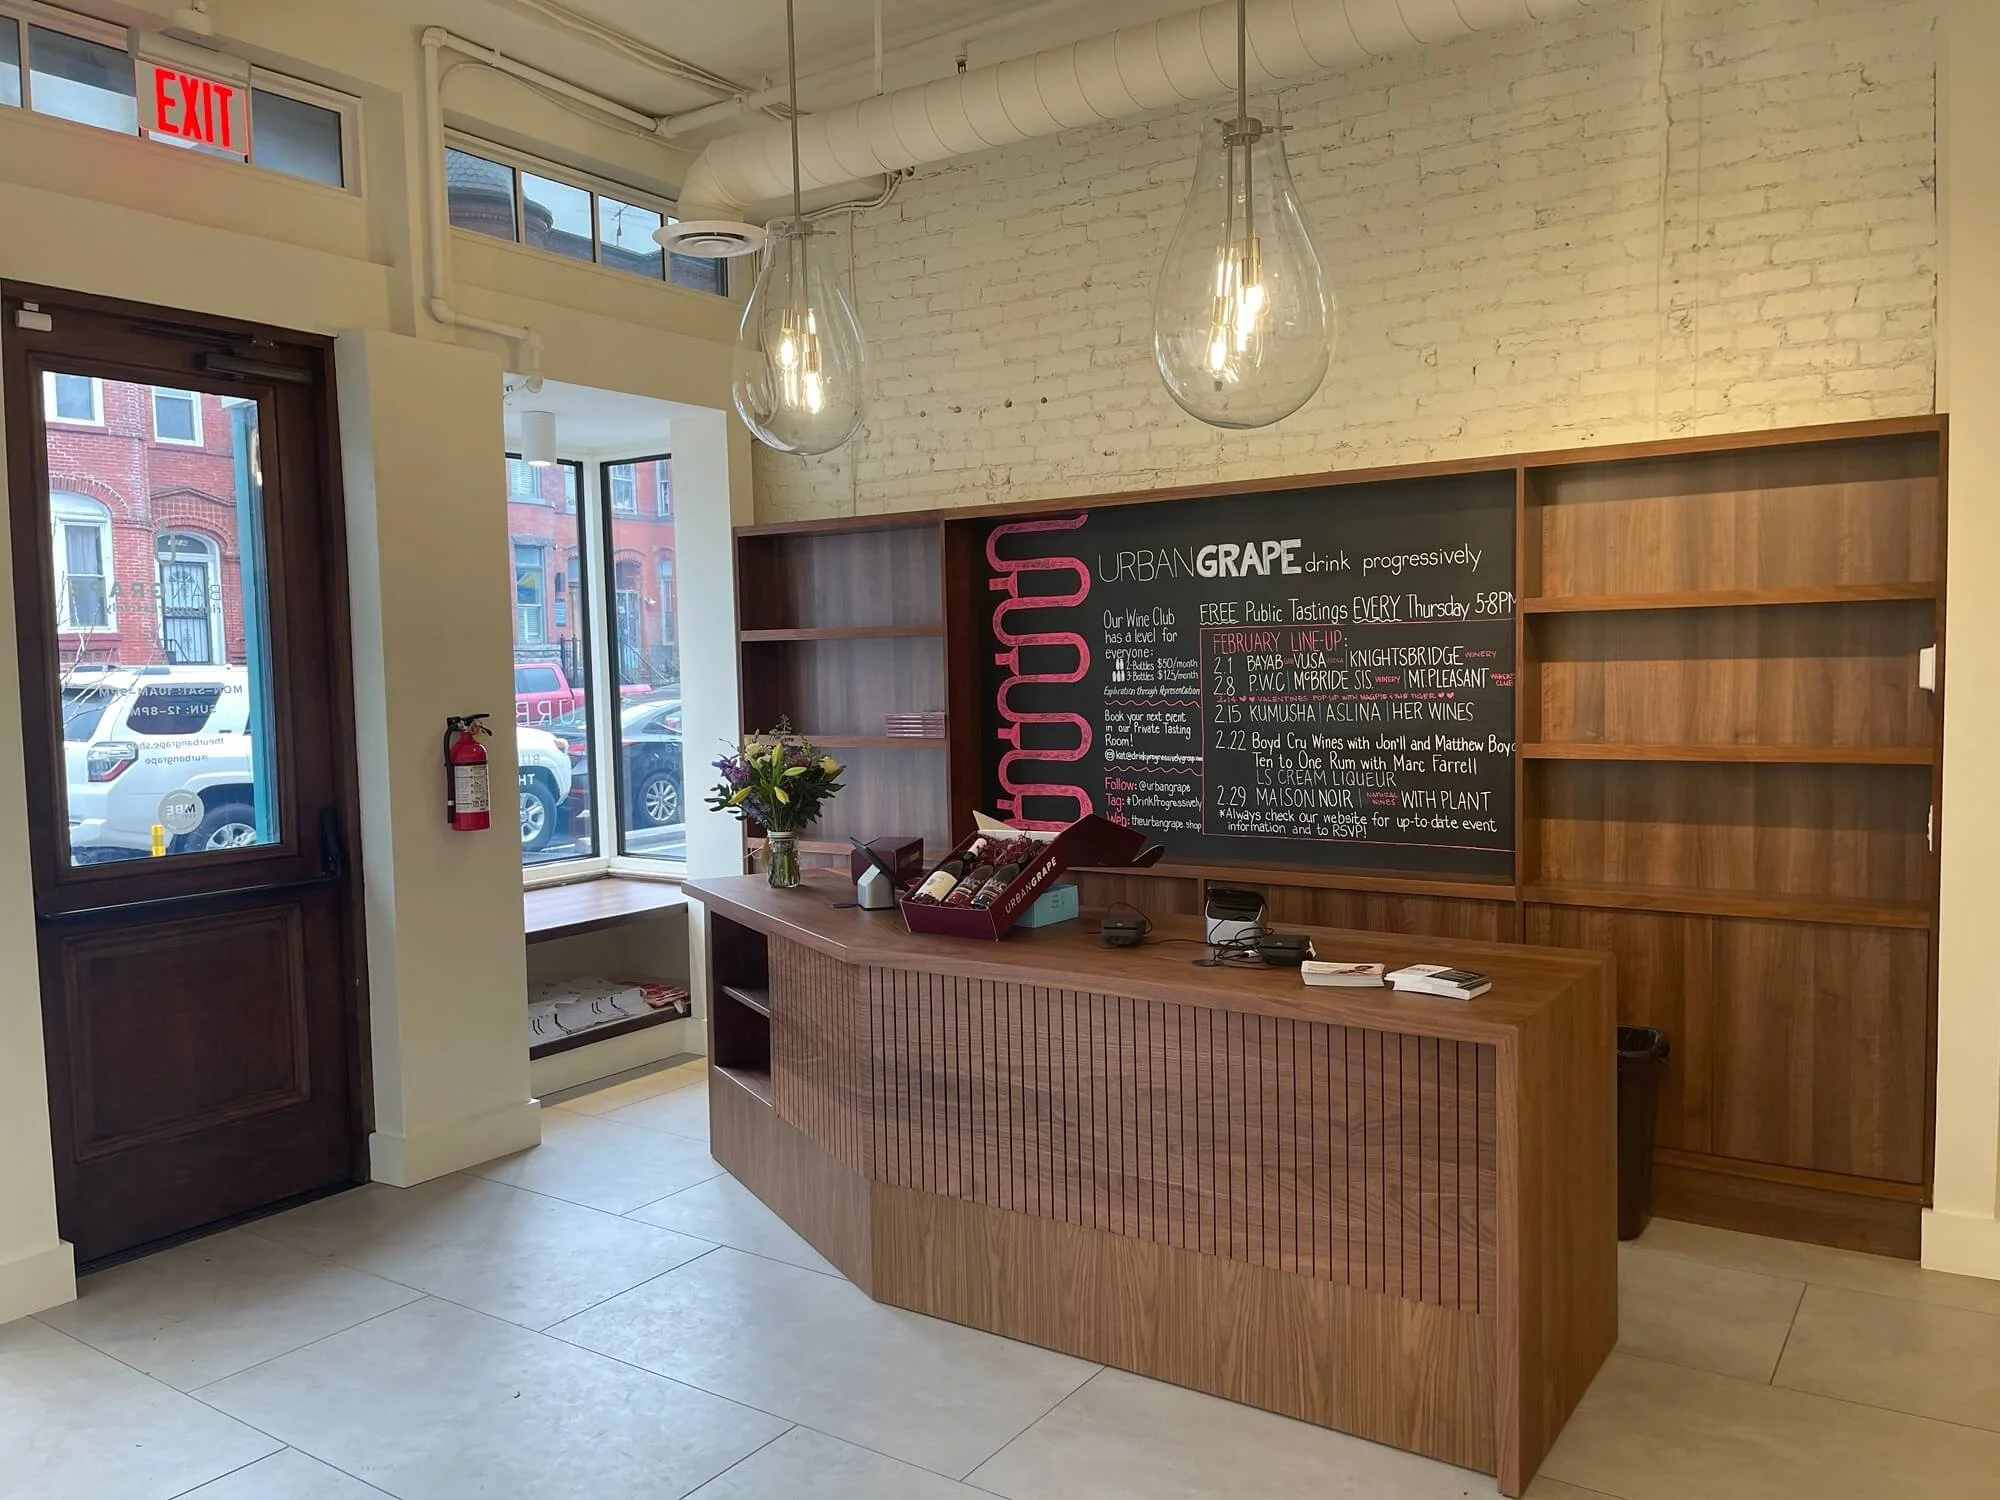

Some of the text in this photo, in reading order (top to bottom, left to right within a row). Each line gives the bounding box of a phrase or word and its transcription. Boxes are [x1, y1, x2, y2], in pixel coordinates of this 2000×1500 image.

[155, 67, 233, 147] EXIT
[1305, 550, 1350, 574] drink
[1363, 543, 1483, 577] progressively
[1104, 606, 1175, 628] Our Wine Club
[1200, 602, 1239, 624] FREE
[1246, 601, 1283, 622] Public
[1288, 599, 1348, 624] Tastings
[1353, 595, 1401, 621] EVERY
[1405, 594, 1470, 621] Thursday
[1105, 627, 1177, 644] has a level for
[1213, 630, 1348, 654] FEBRUARY LINE-UP:
[1105, 648, 1154, 660] everyone:
[1126, 657, 1198, 671] 2-Bottles $50/month
[1213, 657, 1232, 674] 2.1
[1247, 654, 1283, 672] BAYAB
[1350, 646, 1464, 667] KNIGHTSBRIDGE
[1465, 650, 1496, 658] WINERY
[1126, 669, 1199, 681] 3-Bottles $125/month
[1213, 675, 1236, 696] 2.8
[1294, 670, 1349, 691] McBRIDE
[1355, 670, 1374, 690] SIS.
[1137, 685, 1157, 698] through
[1105, 709, 1187, 725] Book your next event
[1214, 702, 1475, 723] 2.15 KUMUSHA ASLINA HER WINES
[1105, 733, 1133, 747] Room!
[1106, 721, 1191, 740] in our Private Tasting
[1215, 730, 1247, 751] 2.22
[1252, 731, 1281, 755] Boyd
[1312, 733, 1344, 750] Wines
[1347, 735, 1370, 750] with
[1410, 736, 1431, 750] and
[1435, 734, 1484, 751] Matthew
[1252, 750, 1477, 775] Ten to One Rum with Marc Farrell
[1105, 777, 1191, 796] Follow: @urbangrape
[1257, 769, 1397, 787] LS CREAM LIQUEUR
[1105, 793, 1202, 812] Tag: #DrinkProgressively
[1217, 785, 1492, 811] 2.29 MAISON NOIR WITH PLANT
[1106, 811, 1202, 832] Web: theurbangrape.shop
[1228, 822, 1368, 839] information and to RSVP!
[1265, 809, 1295, 822] check
[1300, 813, 1319, 823] our
[1323, 811, 1367, 825] website
[1371, 812, 1390, 827] for
[1462, 818, 1498, 832] event
[1005, 856, 1057, 914] URBANGRAPE
